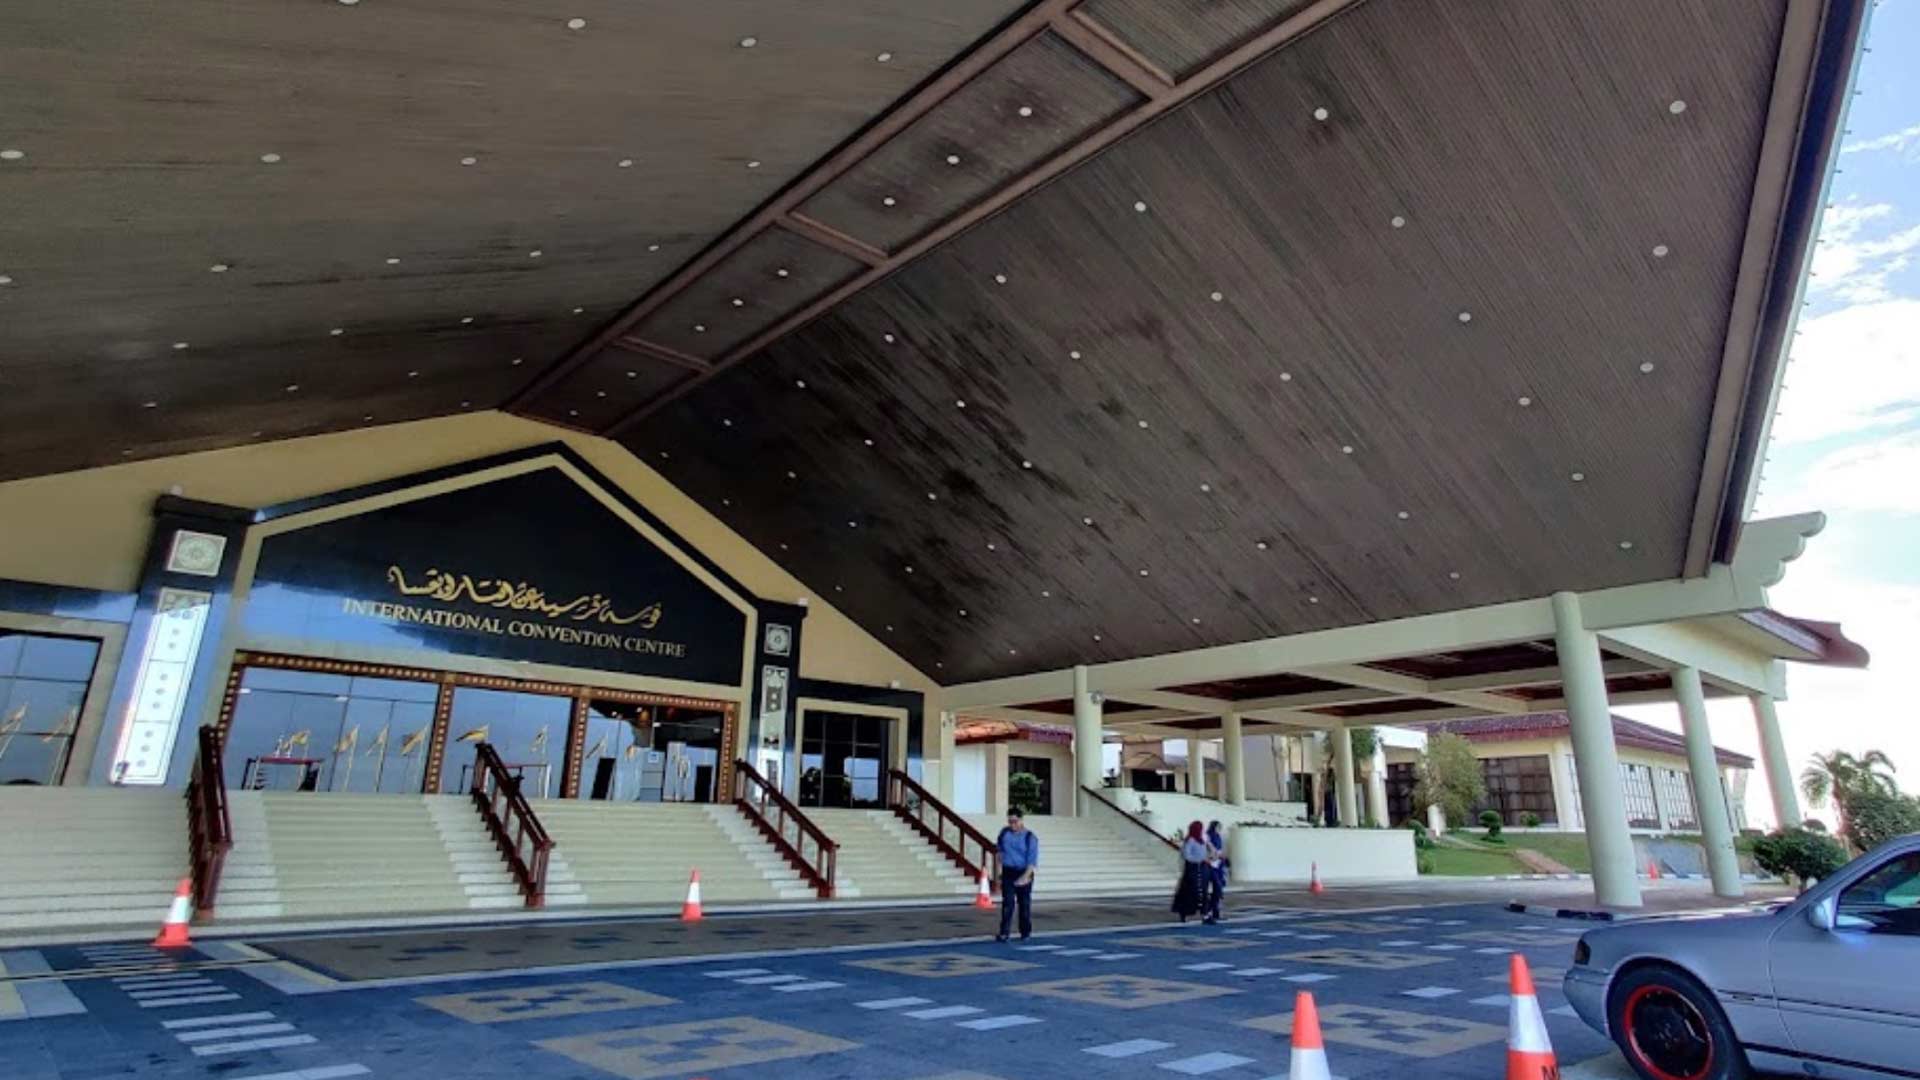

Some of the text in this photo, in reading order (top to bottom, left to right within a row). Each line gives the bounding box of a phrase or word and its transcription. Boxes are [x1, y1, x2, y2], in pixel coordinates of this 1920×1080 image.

[342, 598, 687, 658] INTERNATIONAL CONVENTION CENTRE
